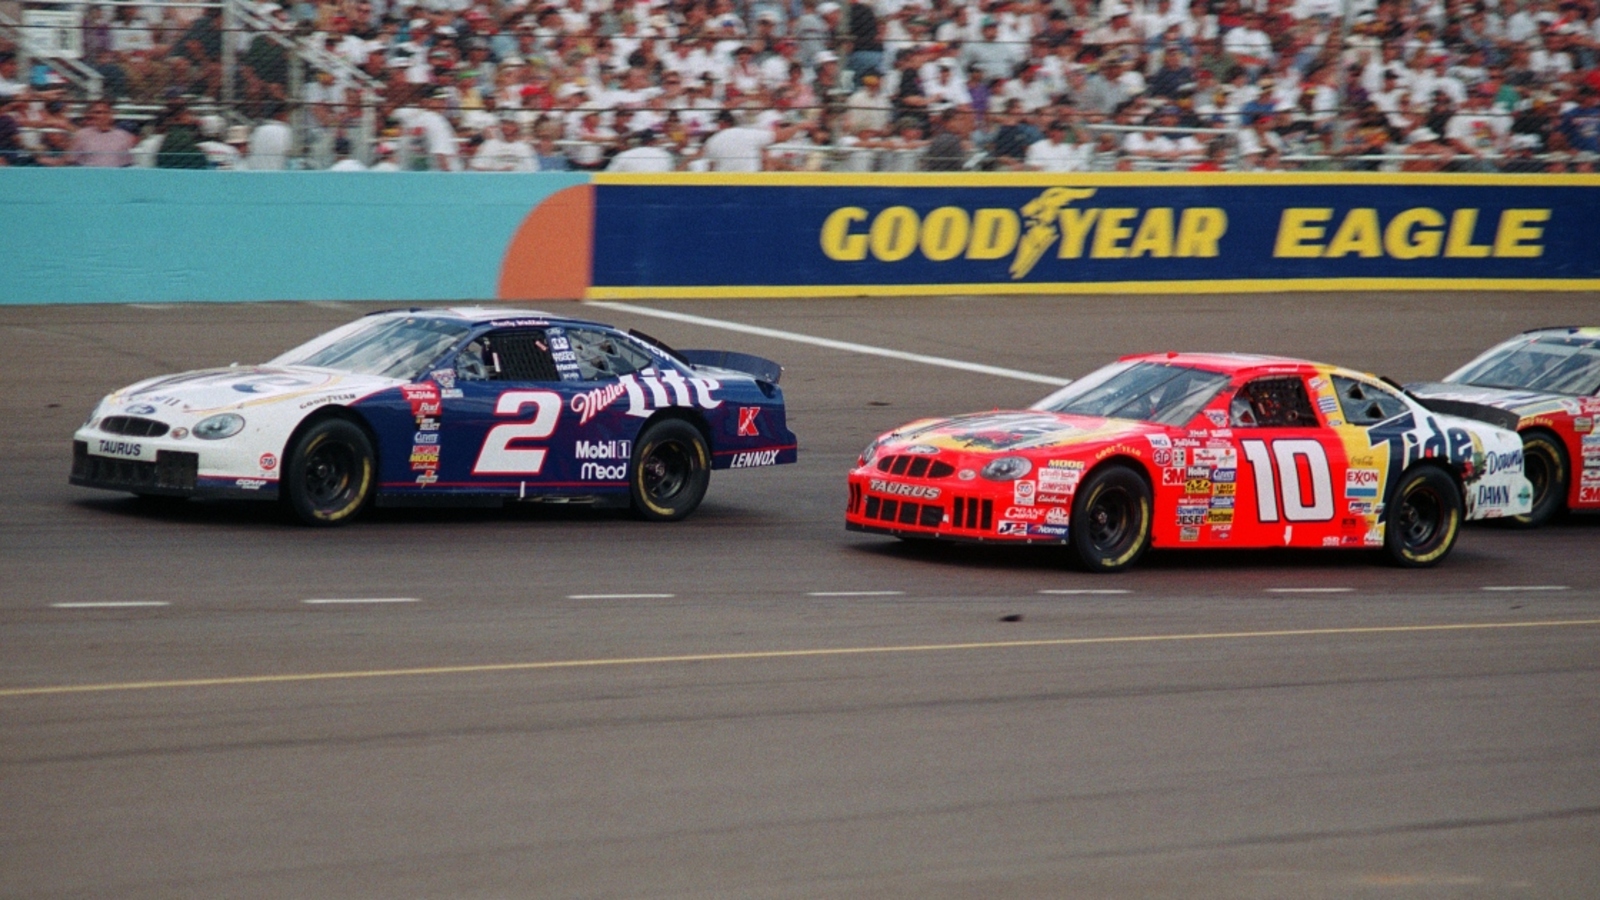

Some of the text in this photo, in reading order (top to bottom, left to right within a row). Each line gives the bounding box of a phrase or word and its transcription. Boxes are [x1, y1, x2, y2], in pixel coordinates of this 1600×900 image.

[820, 205, 1553, 262] GOODYEAR EAGLE
[299, 393, 357, 409] GOODYEAR
[570, 369, 722, 426] Miller Lite
[737, 407, 760, 436] K
[471, 388, 562, 476] 2
[99, 440, 142, 456] TAURUS
[575, 440, 616, 459] Mobil
[729, 450, 779, 468] LENNOX
[1048, 459, 1085, 469] MOOG
[1366, 411, 1474, 523] Tide
[1486, 449, 1522, 475] Downy
[581, 462, 626, 479] Mead
[1164, 469, 1185, 484] 3M
[1241, 438, 1335, 522] 10
[1347, 470, 1379, 486] EXXON
[870, 478, 942, 499] TAURUS
[1478, 484, 1509, 506] DAWN
[1177, 515, 1205, 525] JESEL
